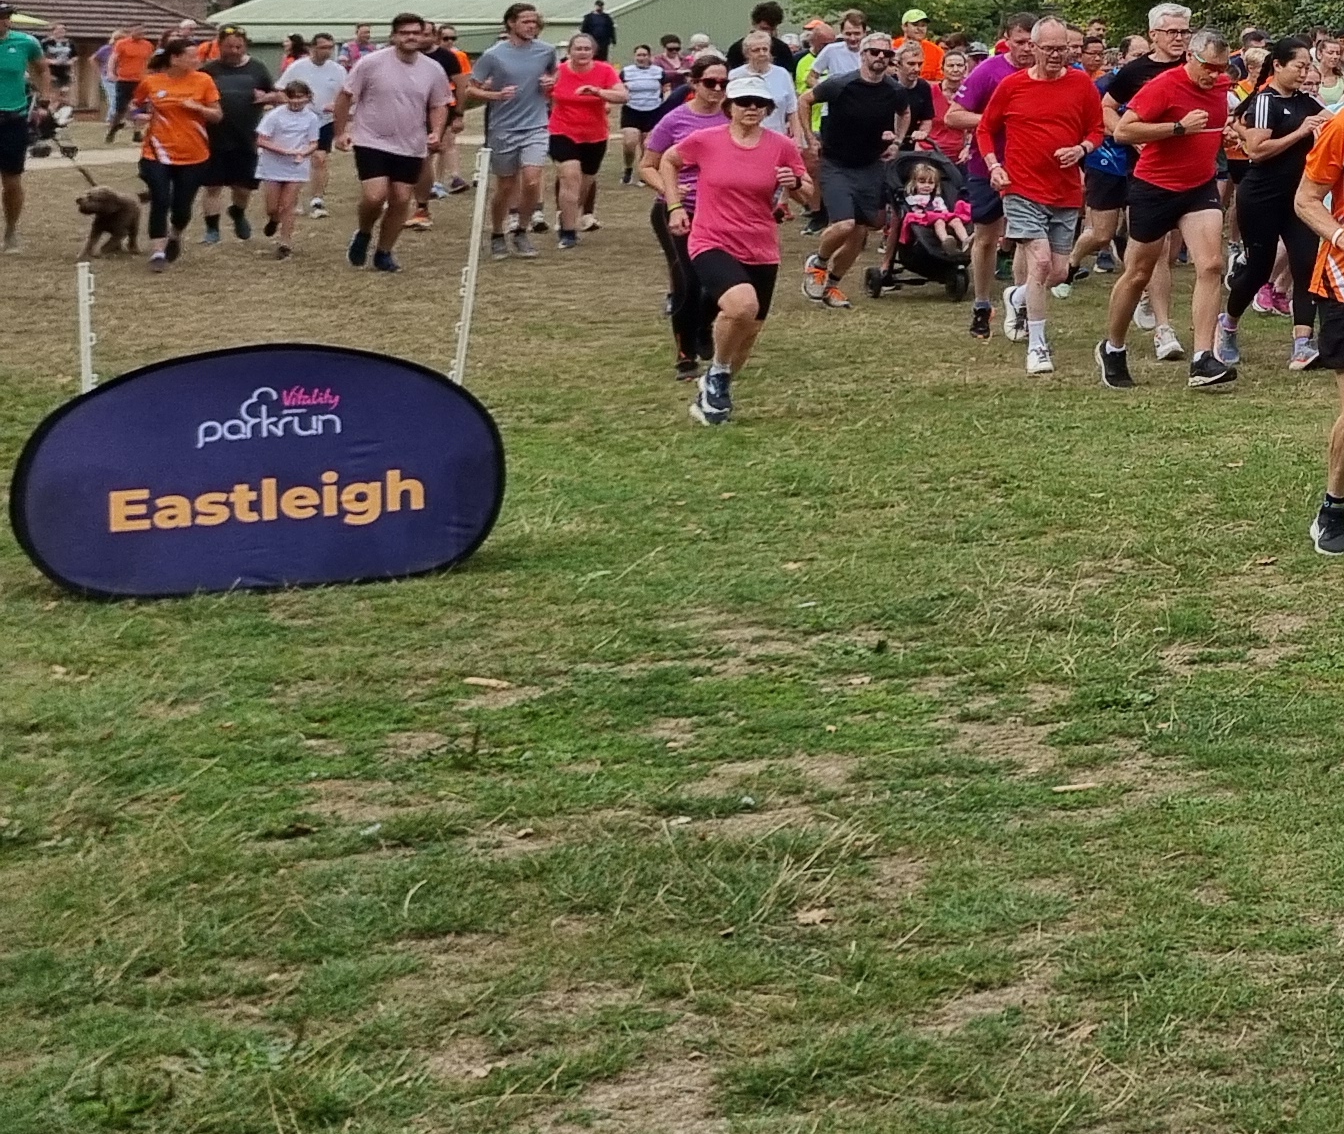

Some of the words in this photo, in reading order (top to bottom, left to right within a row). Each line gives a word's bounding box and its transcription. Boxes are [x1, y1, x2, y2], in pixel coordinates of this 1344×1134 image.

[281, 385, 341, 411] Vitality
[196, 400, 342, 449] parkrun
[108, 469, 426, 533] Eastleigh
